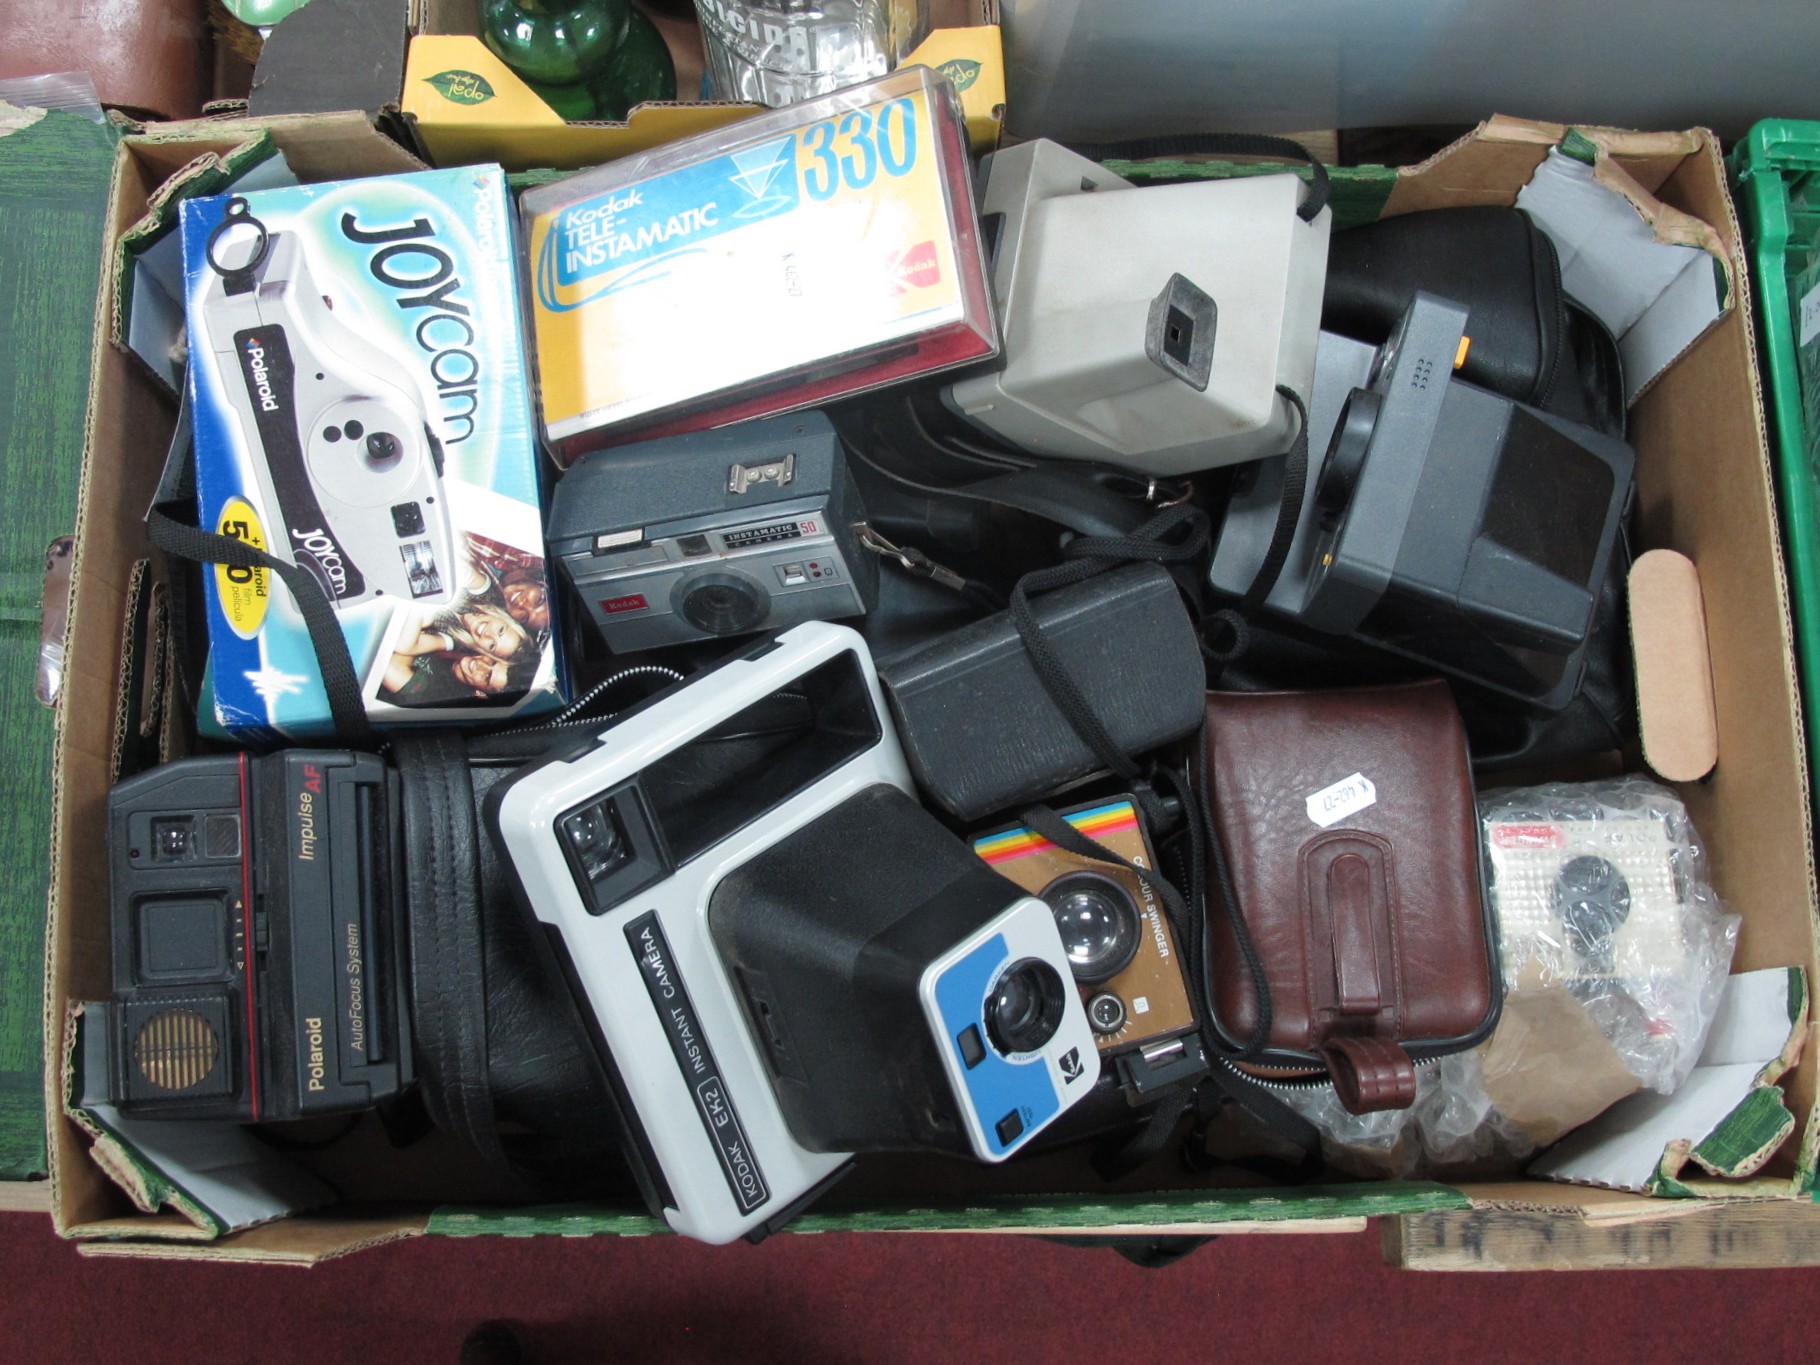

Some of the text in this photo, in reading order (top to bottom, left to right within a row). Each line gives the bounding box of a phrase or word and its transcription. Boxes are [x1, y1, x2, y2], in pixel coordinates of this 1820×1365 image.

[950, 64, 975, 84] op
[803, 97, 917, 201] 330
[564, 216, 626, 249] TELE-
[565, 190, 645, 230] Kodak
[565, 202, 719, 272] INSTAMATIC
[341, 211, 480, 446] JOYcam
[247, 347, 279, 412] Polaroid
[223, 520, 253, 606] 50 film
[294, 527, 348, 595] JOYcam
[728, 520, 816, 542] INSTAMATIC 50
[735, 533, 795, 548] CAMERA
[608, 598, 641, 610] Kodak
[298, 764, 321, 860] Impulse AF
[1358, 779, 1369, 793] K
[1133, 855, 1169, 958] COUR SWINGER
[347, 923, 364, 1051] AutoFocus System
[307, 1017, 323, 1092] Polaroid
[640, 926, 758, 1198] KODAK EK2 INSTANT CAMERA
